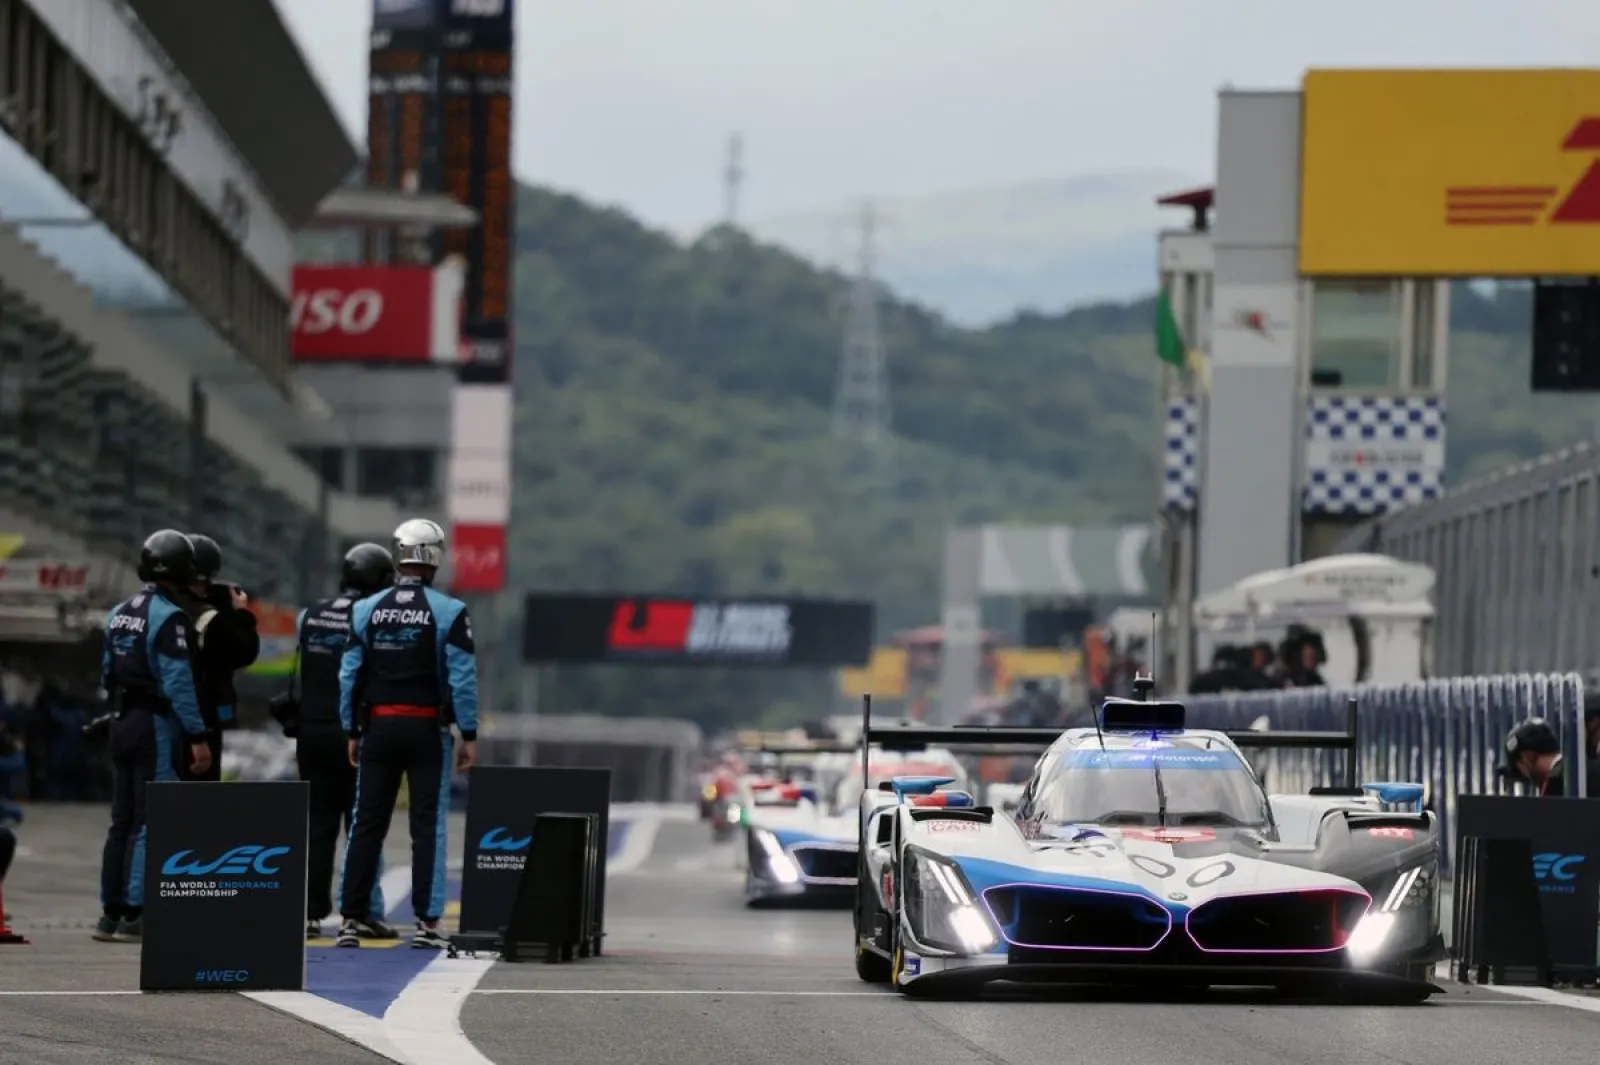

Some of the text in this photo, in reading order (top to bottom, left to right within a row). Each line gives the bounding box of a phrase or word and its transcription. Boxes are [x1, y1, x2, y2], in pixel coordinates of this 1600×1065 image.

[371, 608, 432, 625] OFFICIAL
[160, 845, 291, 875] WEC
[1532, 852, 1585, 880] EC
[160, 881, 280, 889] FIA WORLD ENDURANCE
[160, 889, 239, 898] CHAMPIONSHIP
[195, 969, 249, 982] #WEC
